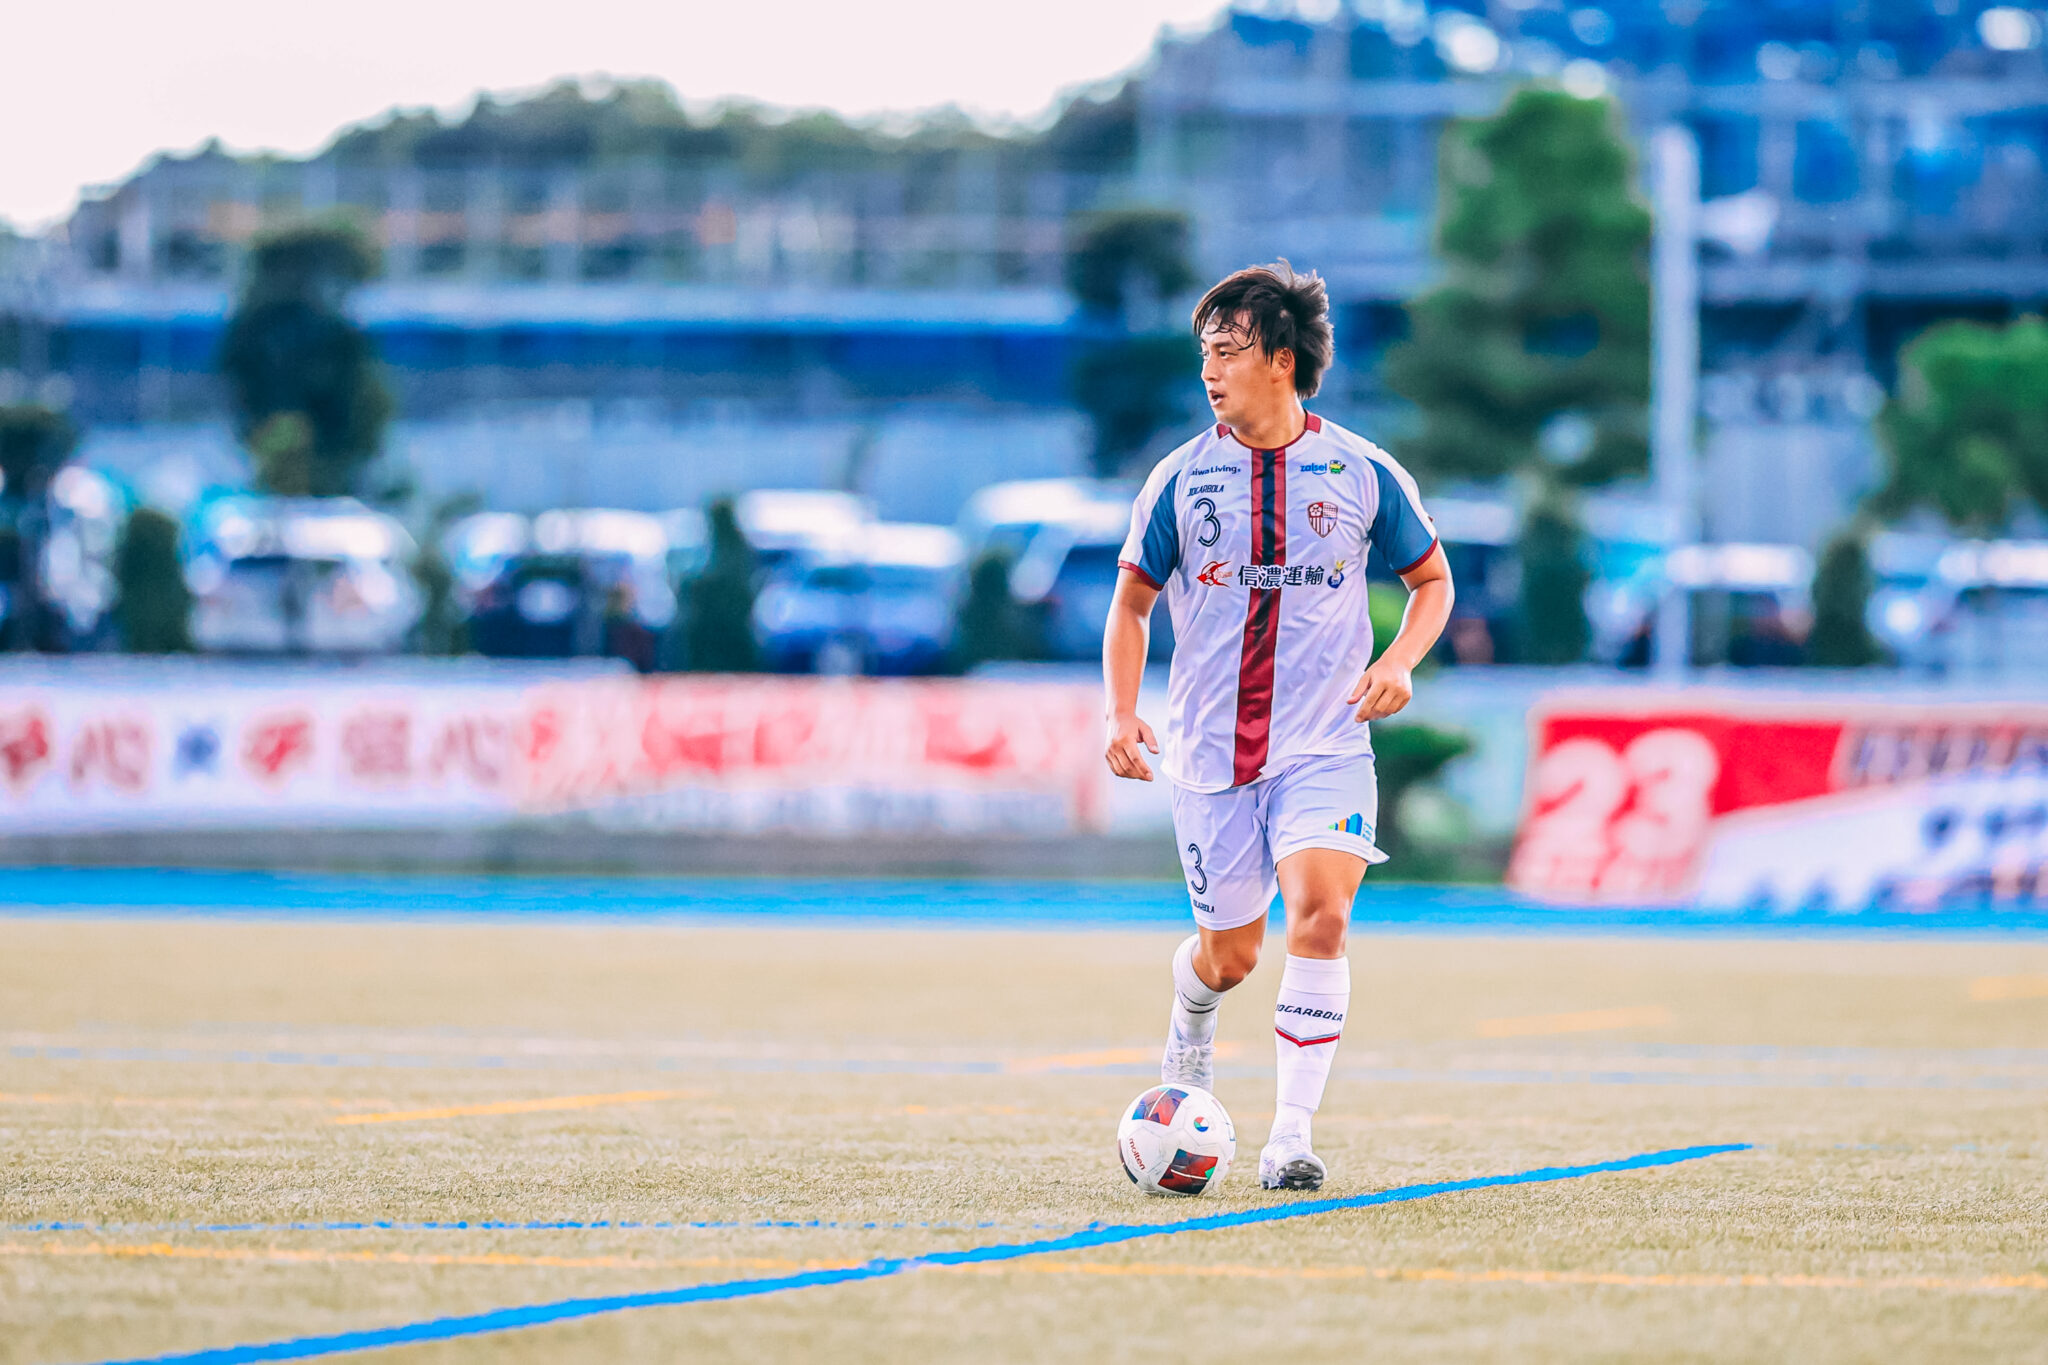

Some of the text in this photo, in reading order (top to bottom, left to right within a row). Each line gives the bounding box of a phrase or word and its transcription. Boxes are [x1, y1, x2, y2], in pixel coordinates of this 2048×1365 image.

[1194, 498, 1221, 547] 3
[1237, 565, 1325, 588] 信濃運輸
[1527, 733, 1720, 864] 23
[1187, 843, 1208, 895] 3
[1129, 1138, 1146, 1171] molten
